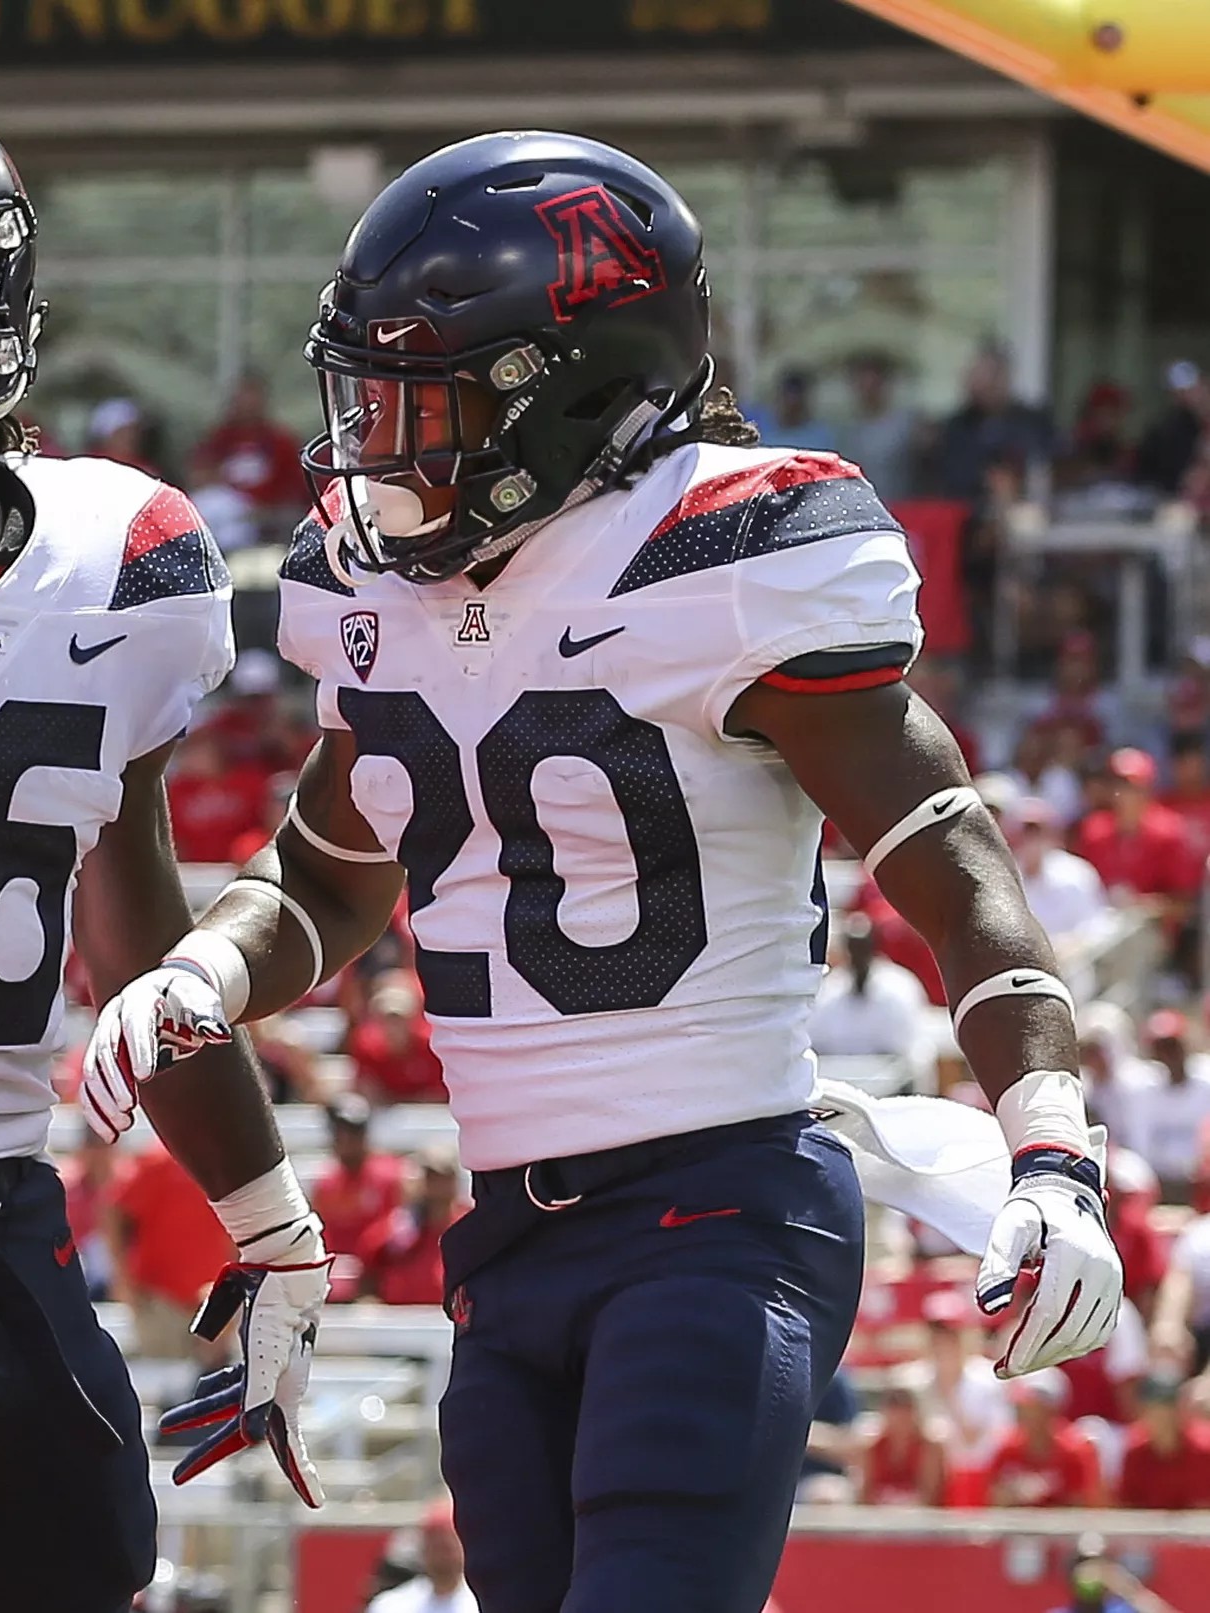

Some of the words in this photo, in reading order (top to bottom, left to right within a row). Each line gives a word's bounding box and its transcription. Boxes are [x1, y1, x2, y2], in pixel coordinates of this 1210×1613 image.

[534, 185, 668, 324] A
[342, 615, 376, 655] PAC
[458, 604, 490, 641] A
[353, 641, 371, 667] 12
[337, 688, 708, 1018] 20
